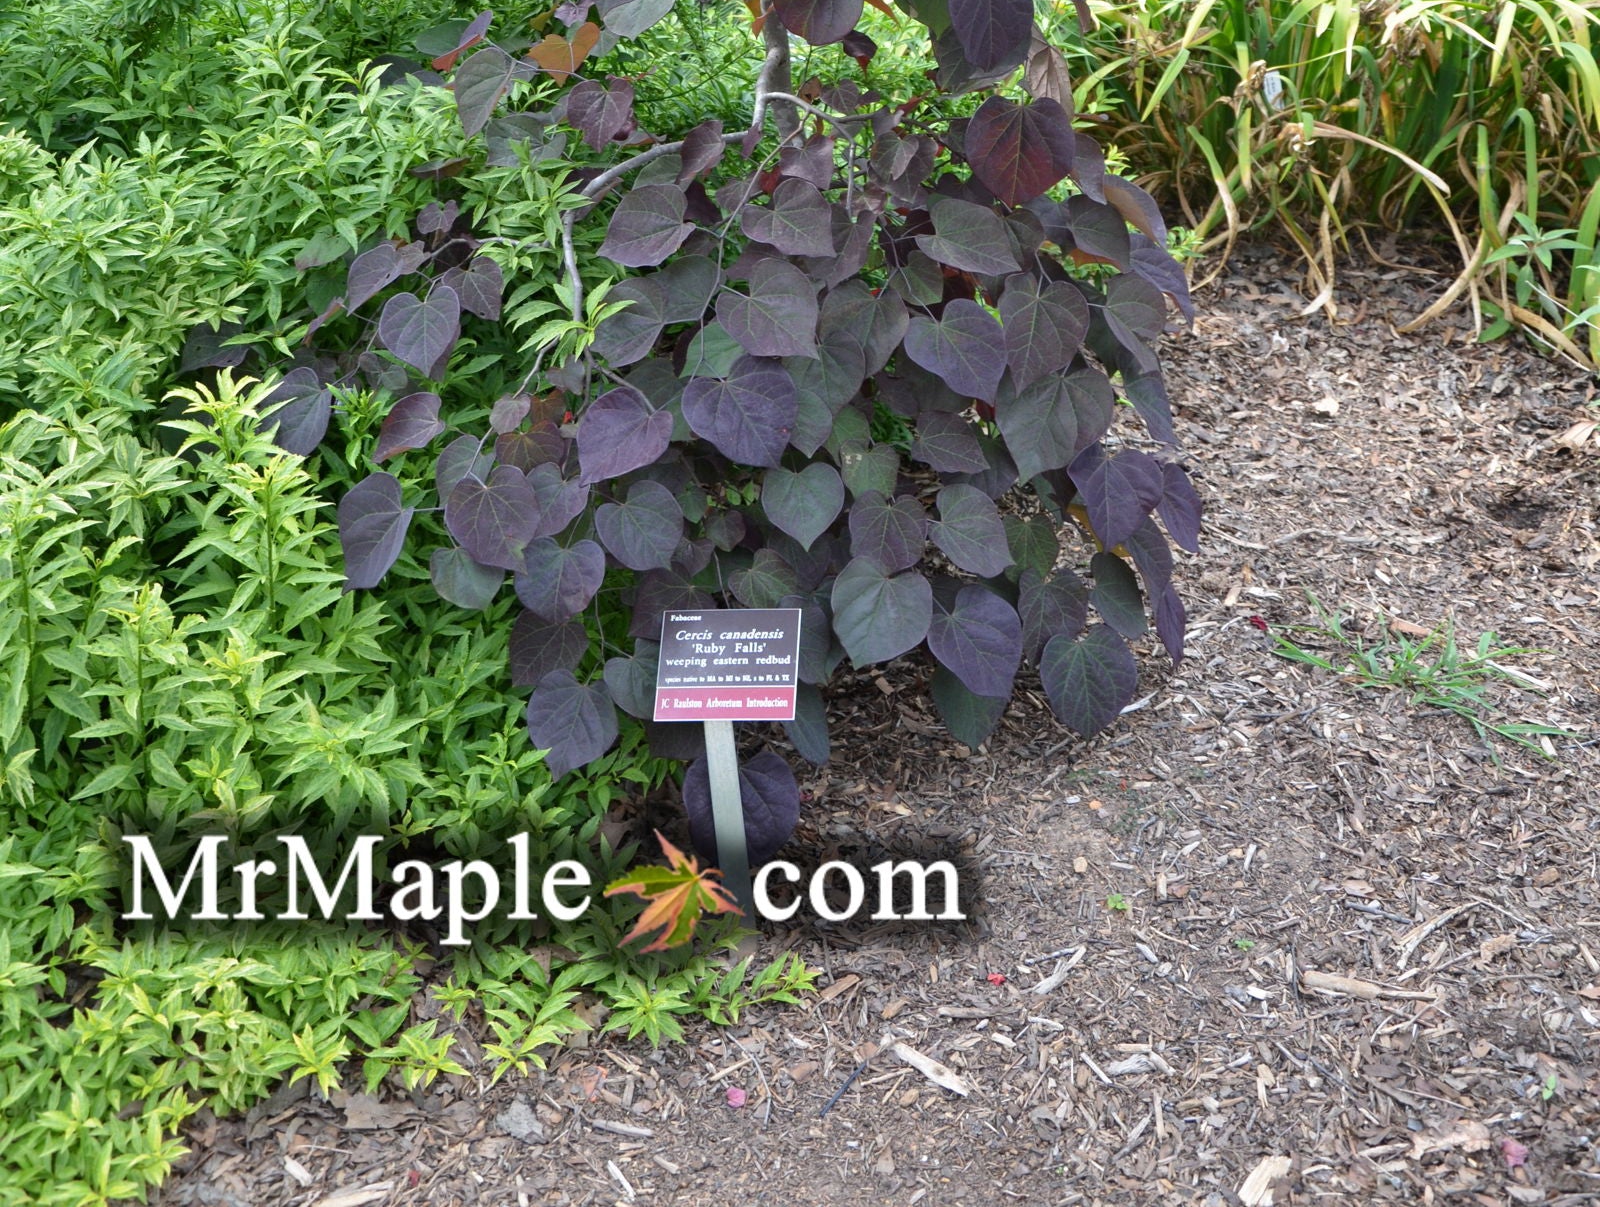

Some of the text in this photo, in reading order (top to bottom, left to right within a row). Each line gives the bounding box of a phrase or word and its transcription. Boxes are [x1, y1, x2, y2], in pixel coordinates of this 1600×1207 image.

[670, 614, 702, 622] Fabaceae
[675, 628, 784, 641] Cercis canadensis
[692, 642, 767, 655] 'Ruby Falls'
[665, 655, 791, 668] weeping eastern redbud
[661, 696, 788, 709] JC Raulston Arboretum Introduction
